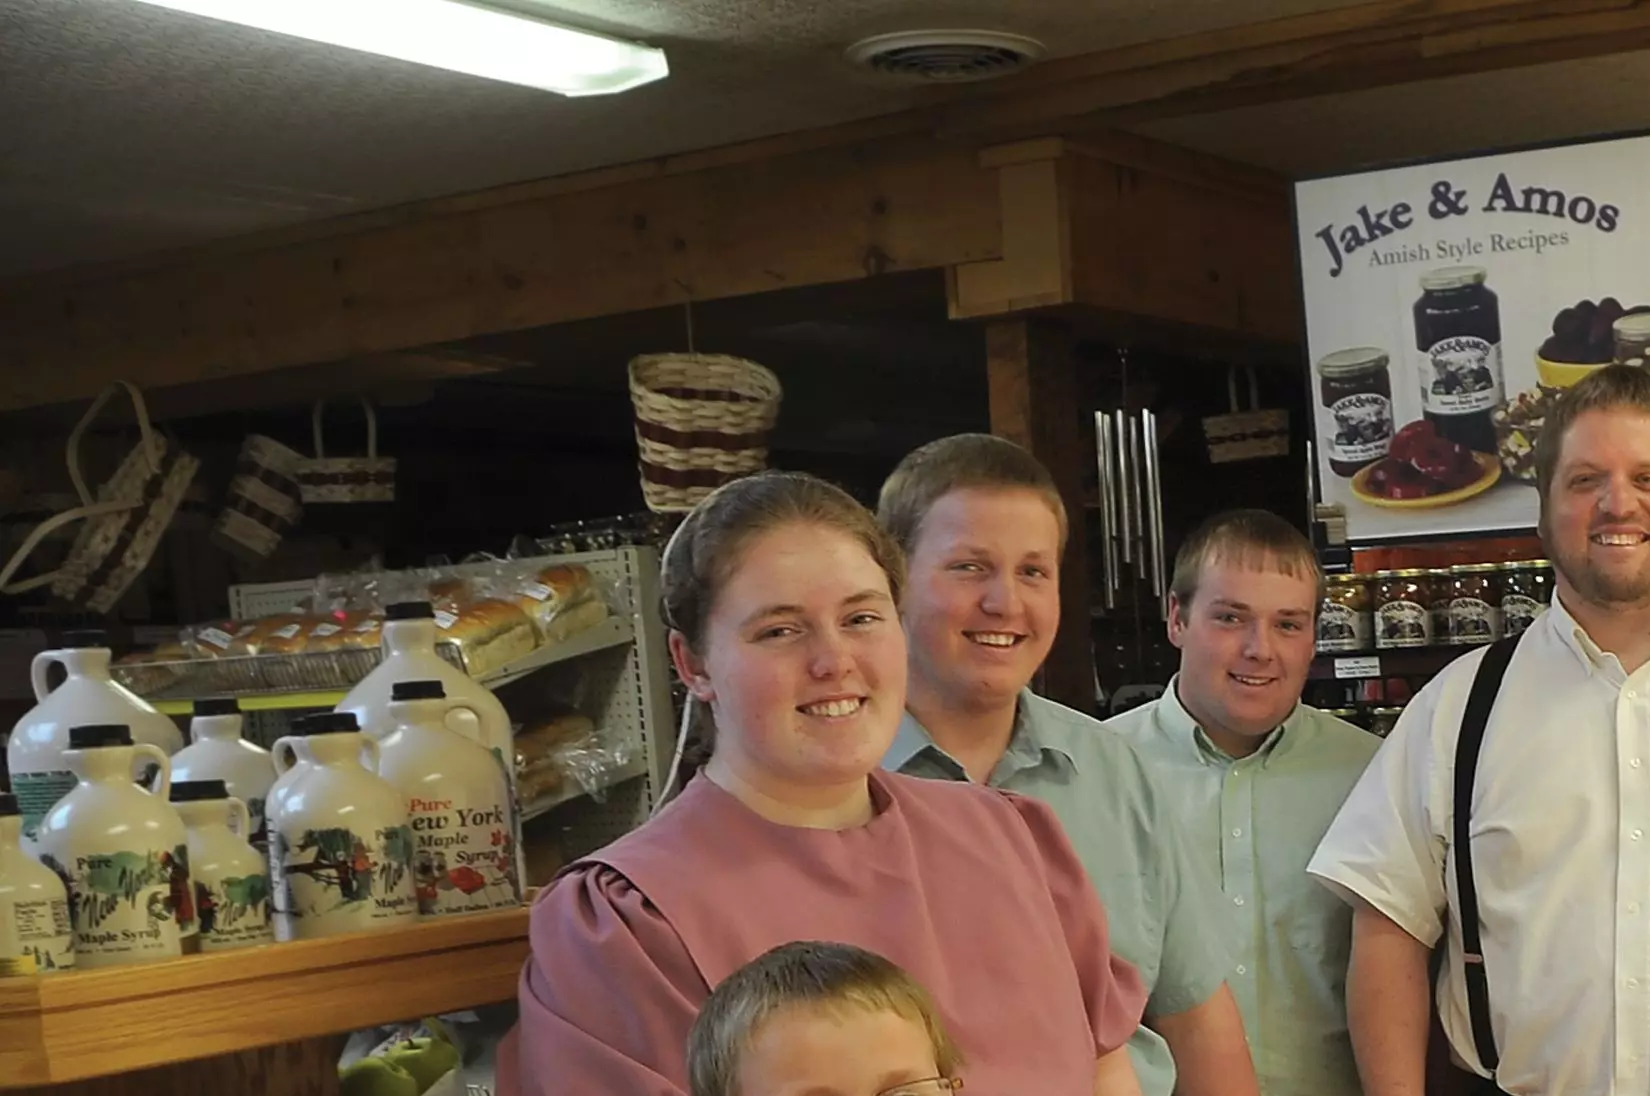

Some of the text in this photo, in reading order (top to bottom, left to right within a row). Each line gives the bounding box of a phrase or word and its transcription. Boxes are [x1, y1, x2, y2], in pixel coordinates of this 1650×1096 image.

[1315, 172, 1620, 277] Jake & Amos
[1368, 229, 1570, 268] Amish Style Recipes
[409, 798, 452, 814] Pure
[410, 804, 504, 832] ew York
[416, 832, 469, 850] Maple
[455, 849, 497, 865] Syrup
[78, 930, 118, 947] Maple
[121, 927, 162, 943] Syrup
